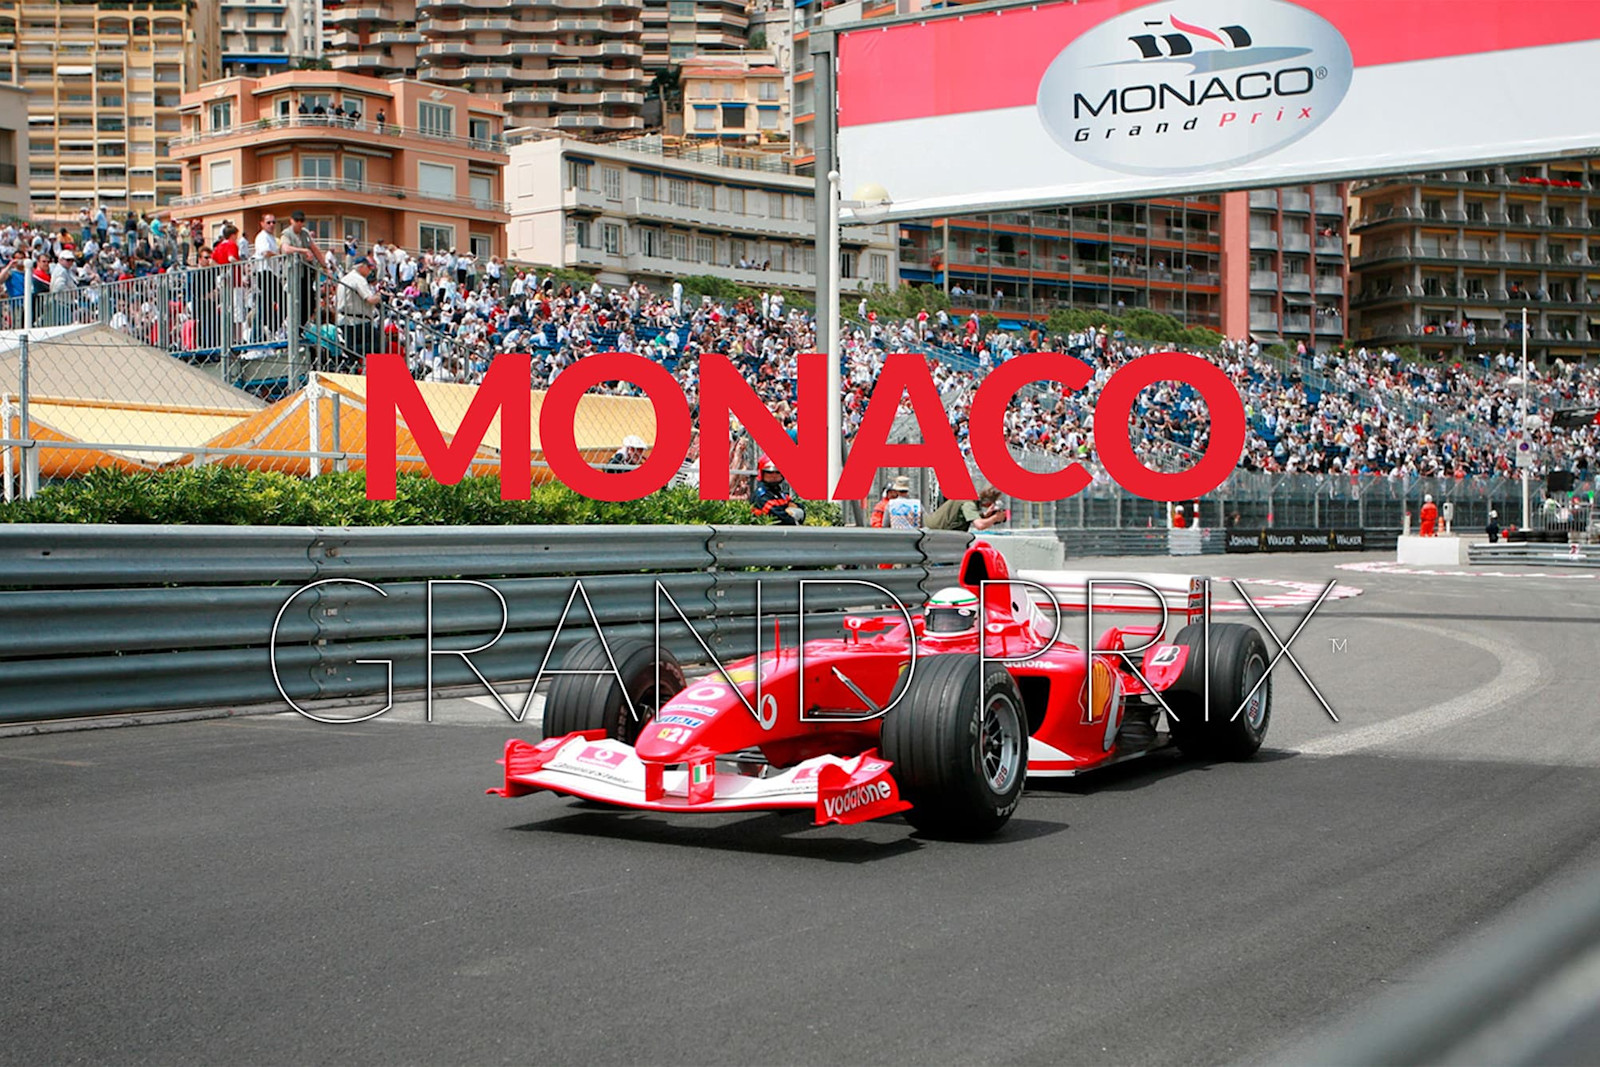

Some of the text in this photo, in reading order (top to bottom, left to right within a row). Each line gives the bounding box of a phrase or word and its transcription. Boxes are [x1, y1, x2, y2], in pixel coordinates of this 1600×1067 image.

[1074, 106, 1312, 142] Grand Prix
[664, 727, 692, 745] 21
